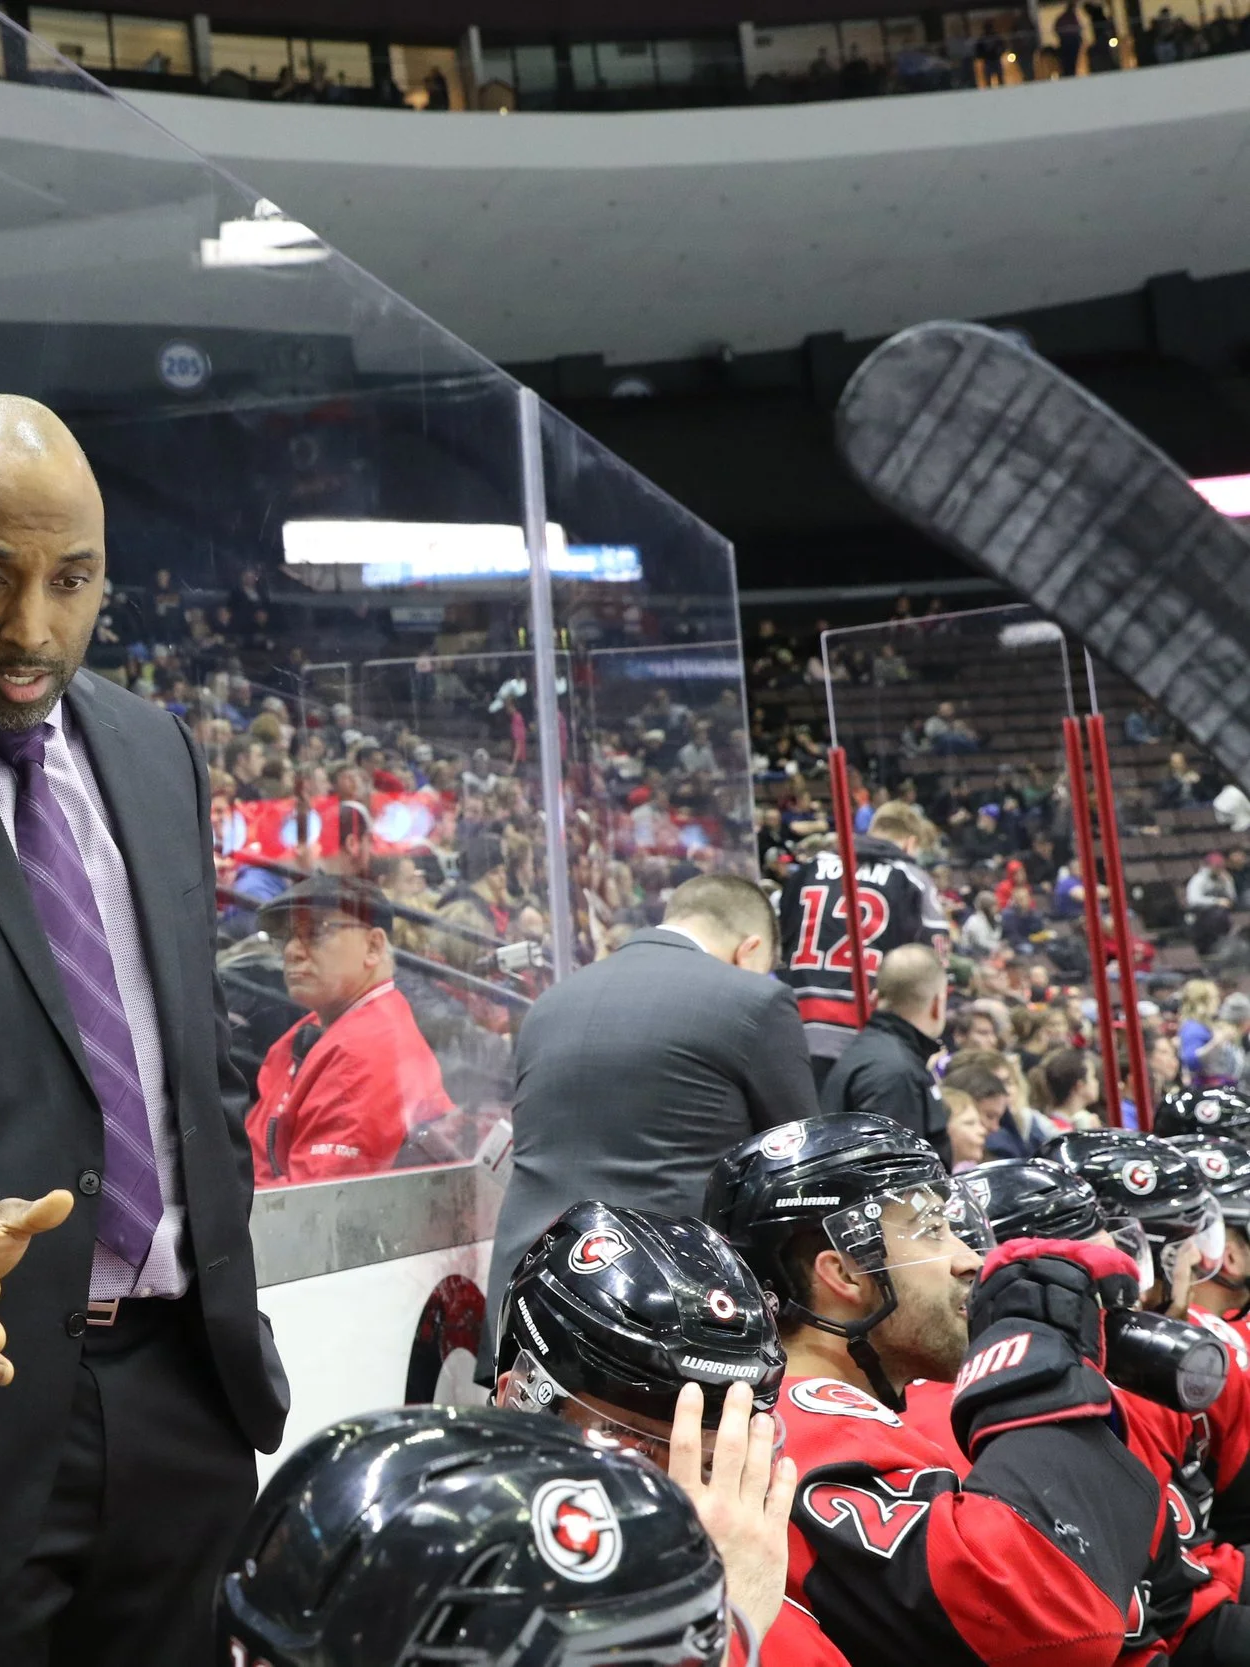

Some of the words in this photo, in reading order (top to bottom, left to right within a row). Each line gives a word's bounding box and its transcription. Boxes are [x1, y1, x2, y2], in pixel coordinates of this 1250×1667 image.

[790, 885, 890, 977] 12
[517, 1296, 550, 1356] WARRIOR
[680, 1354, 759, 1378] WARRIOR
